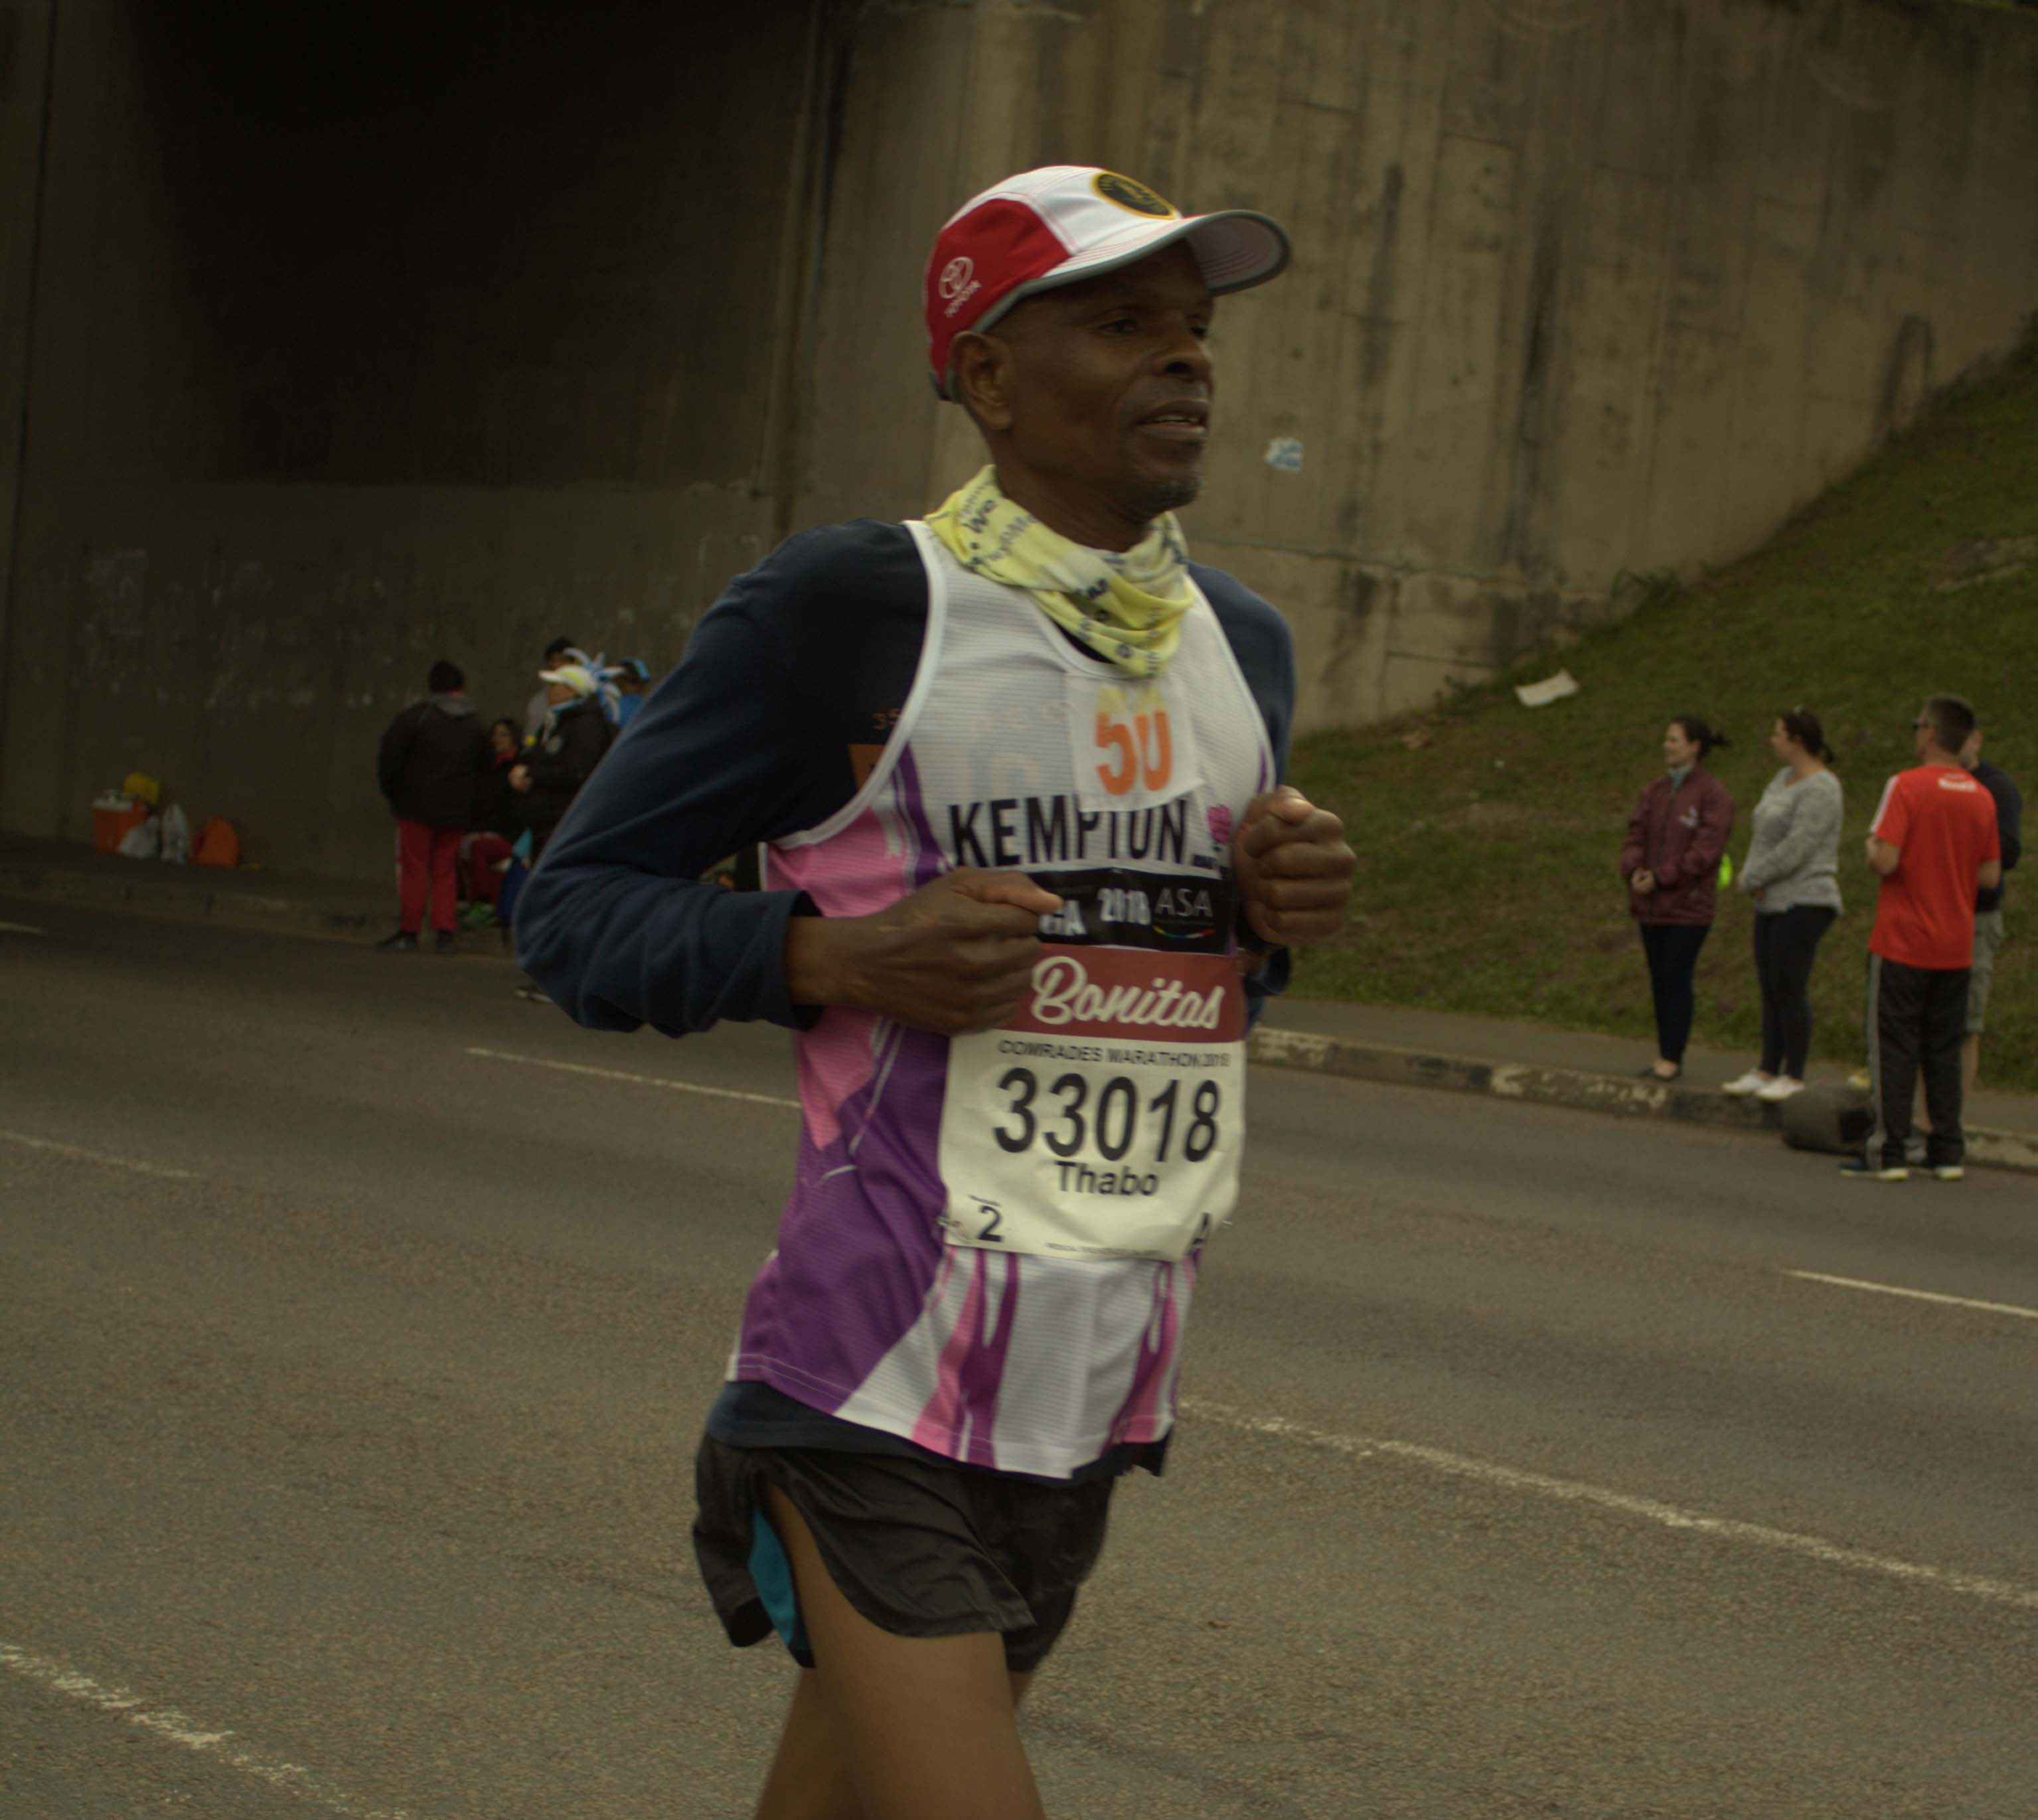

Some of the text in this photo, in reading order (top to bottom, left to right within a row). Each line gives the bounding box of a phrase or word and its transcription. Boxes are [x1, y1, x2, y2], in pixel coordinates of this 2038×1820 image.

[1095, 688, 1174, 796] 50
[1154, 887, 1214, 918] ASA
[1030, 955, 1226, 1030] Bonitas
[998, 1039, 1103, 1062] COMRADES
[993, 1067, 1220, 1163] 33018
[1054, 1160, 1159, 1196] Thabo
[977, 1204, 1004, 1243] 2
